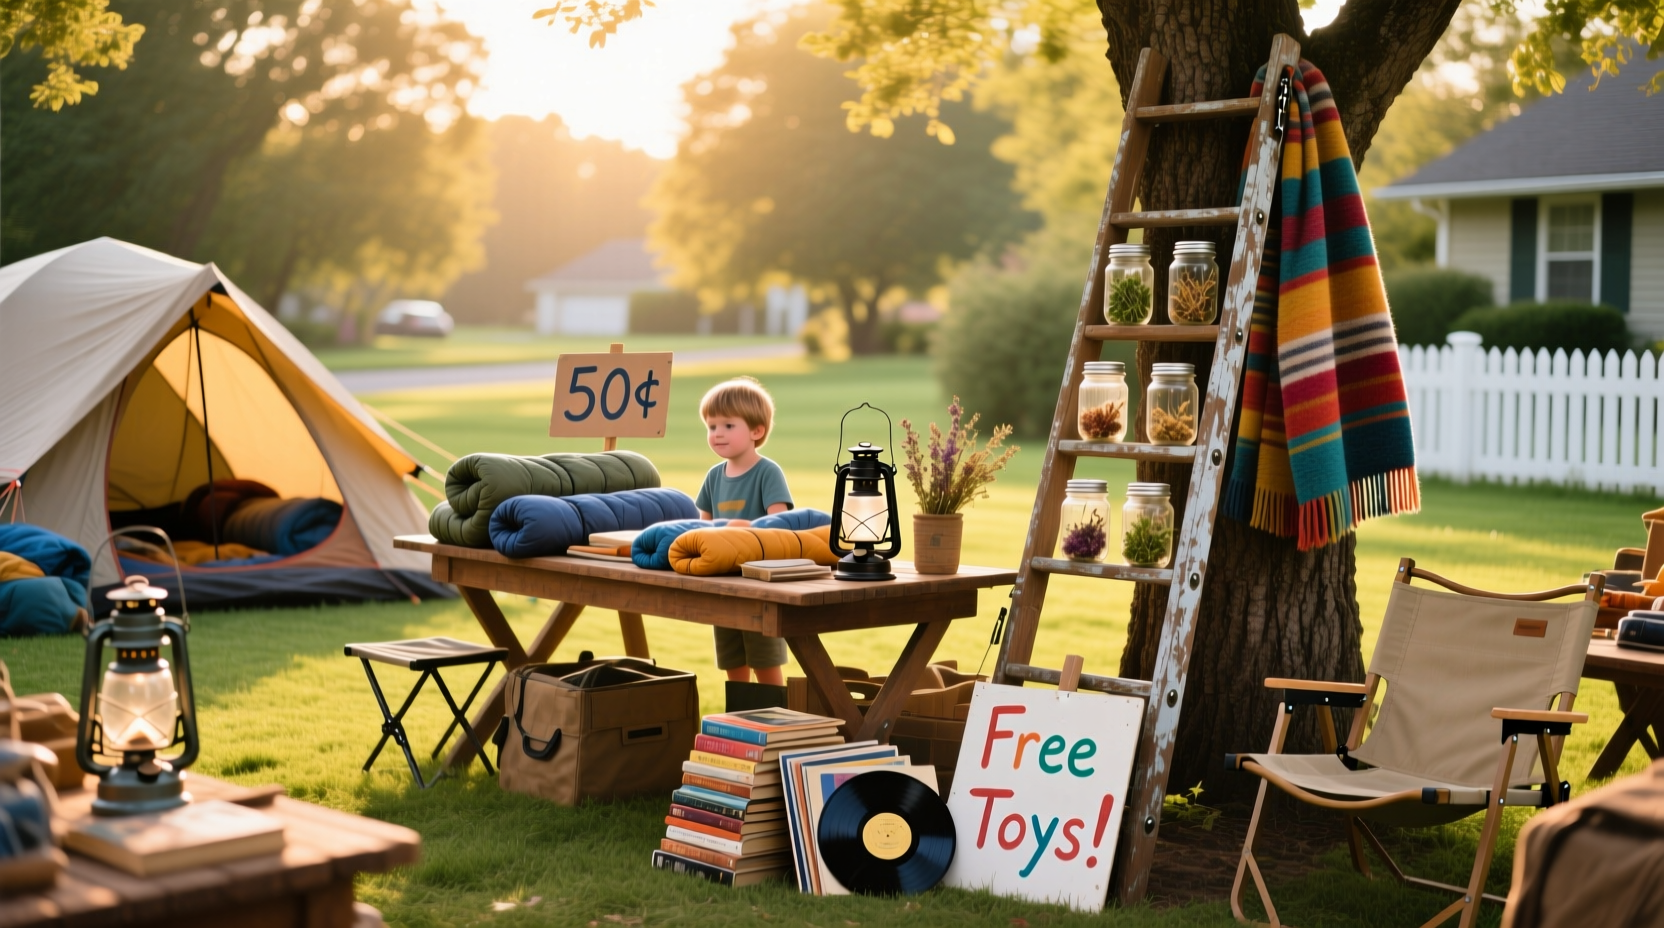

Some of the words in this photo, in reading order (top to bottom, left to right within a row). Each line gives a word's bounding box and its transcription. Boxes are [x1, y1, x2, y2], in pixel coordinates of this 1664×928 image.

[563, 365, 660, 422] 50¢
[980, 705, 1097, 778] Free
[969, 788, 1115, 878] Toys!
